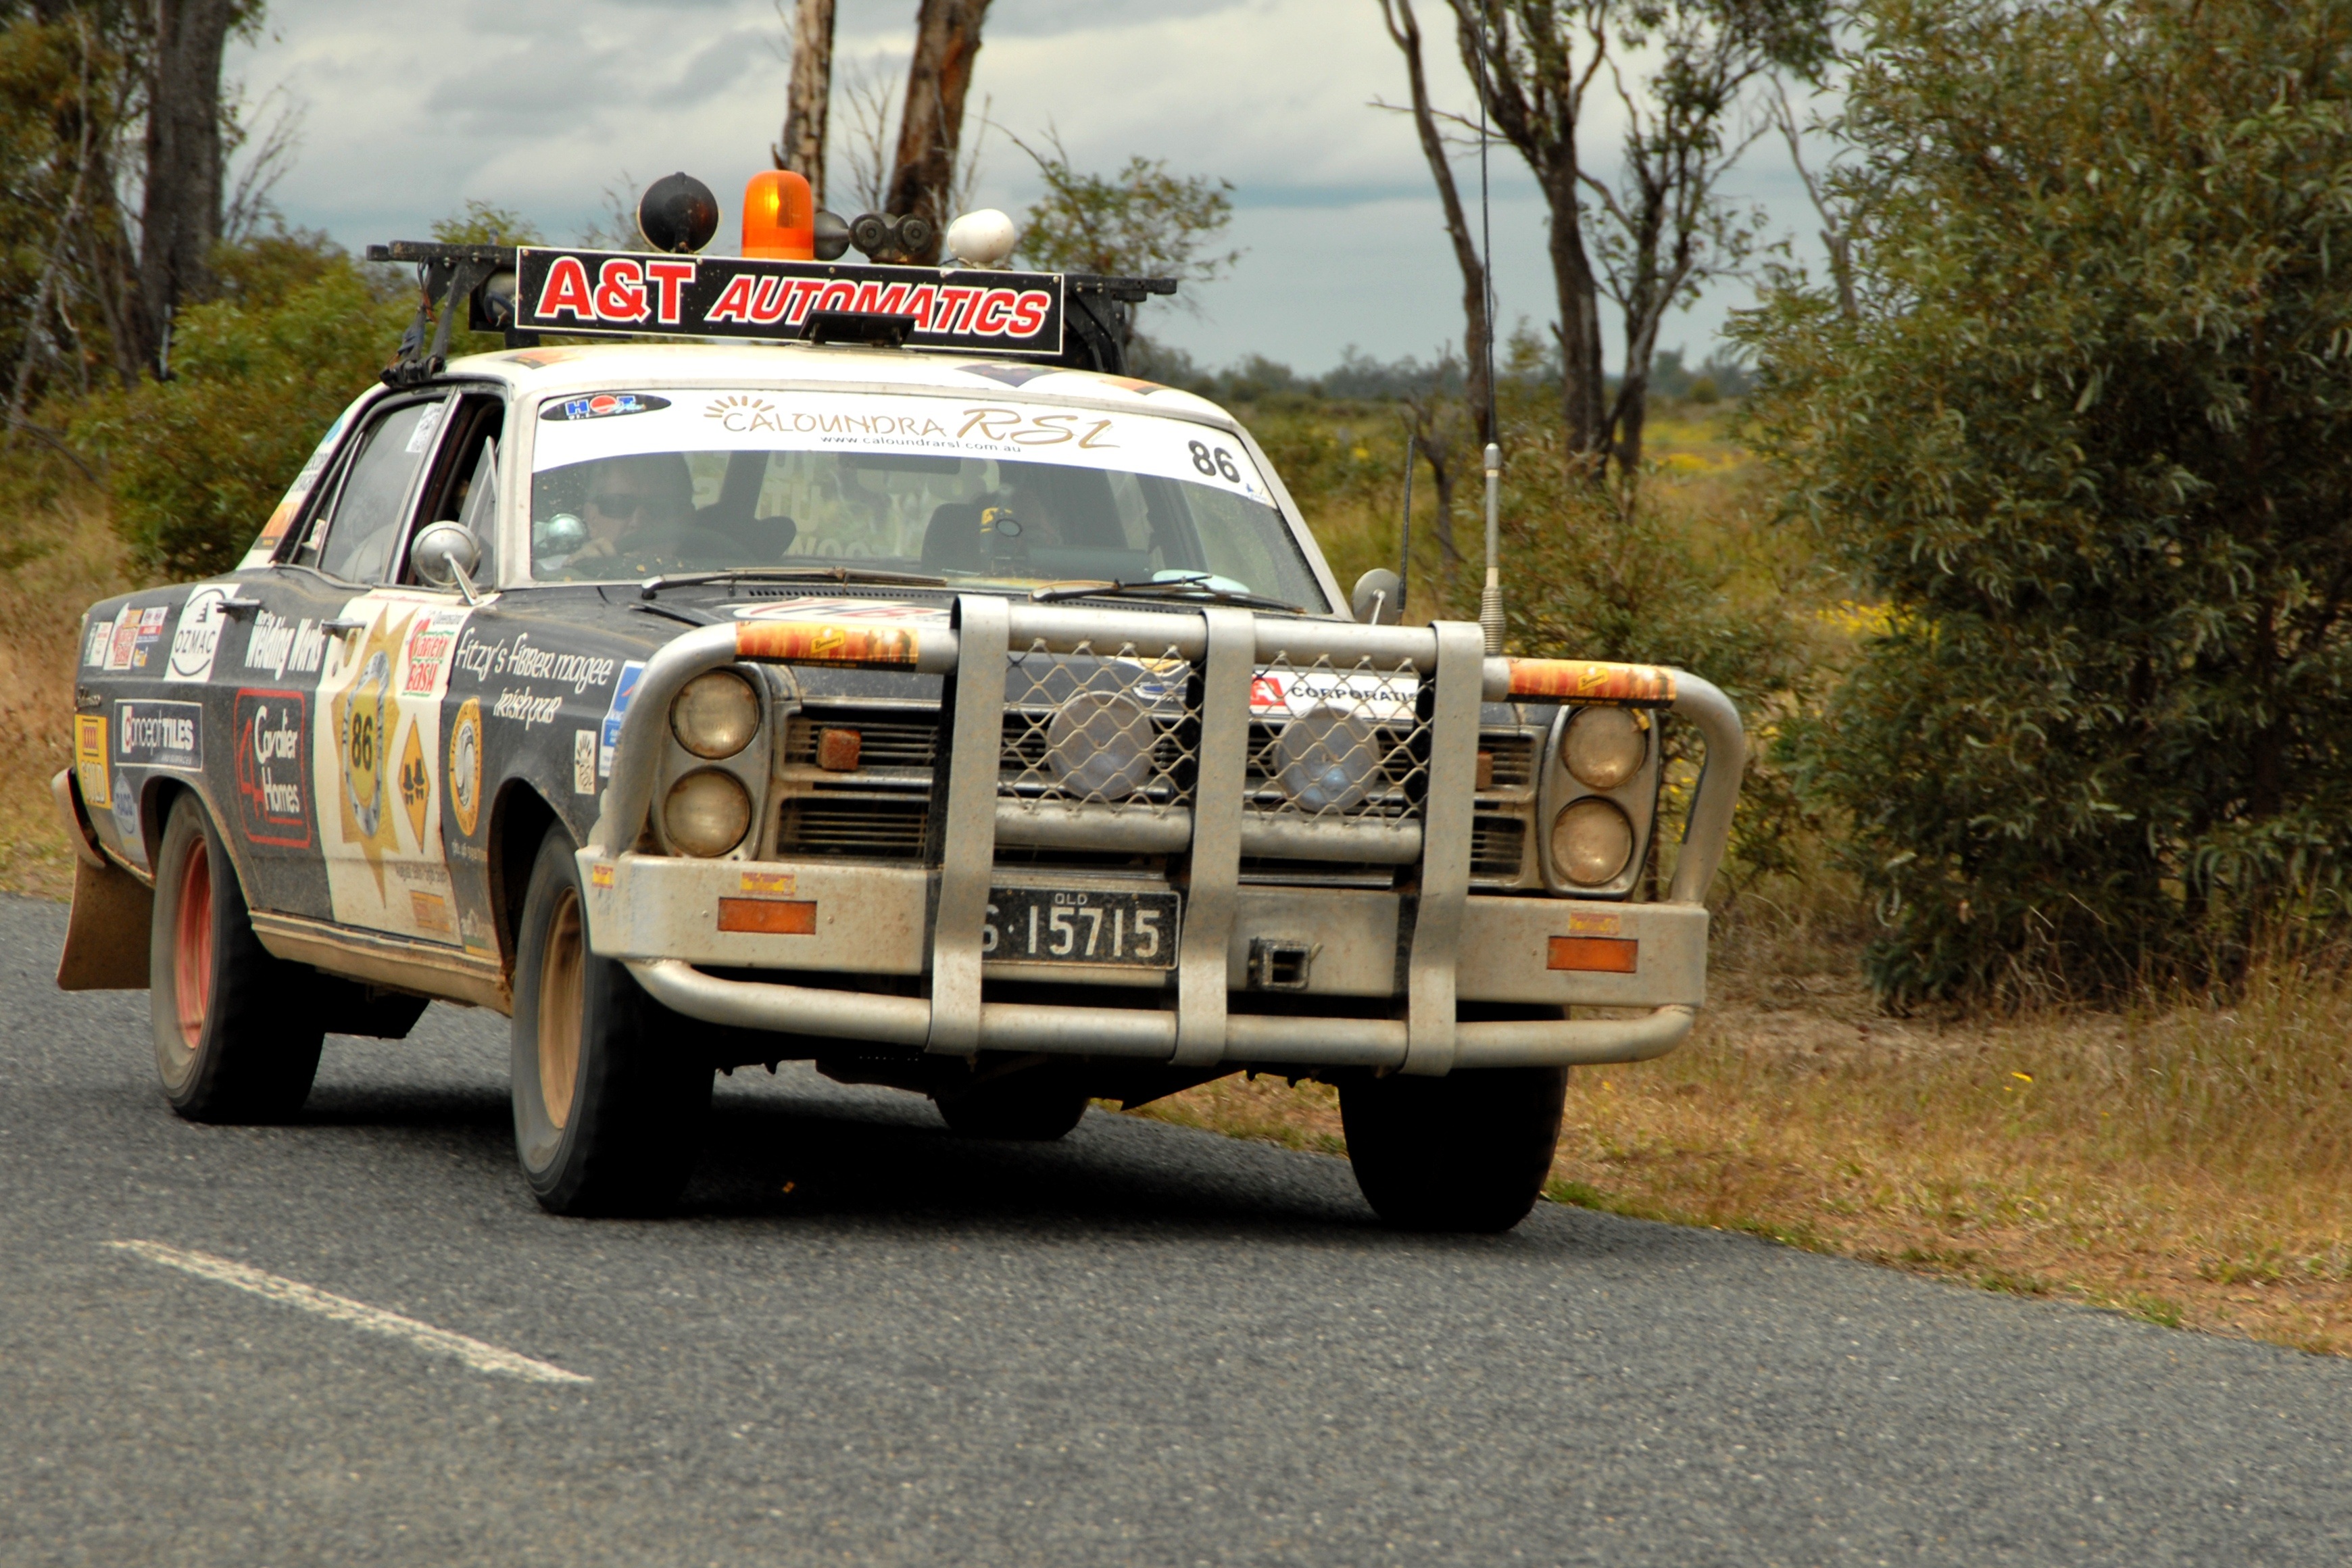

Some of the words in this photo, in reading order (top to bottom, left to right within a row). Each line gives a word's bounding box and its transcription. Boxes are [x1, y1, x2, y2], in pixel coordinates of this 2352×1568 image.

[535, 256, 695, 324] A&T
[706, 274, 1052, 339] AUTOMATICS
[723, 412, 947, 437] CALOUNDRA
[957, 408, 1121, 449] RSL
[820, 436, 1022, 453] www.caloundrarsl.com.au
[1187, 439, 1241, 484] 86
[174, 629, 217, 654] OZMAC
[351, 712, 374, 771] 86
[262, 766, 300, 813] Homes
[1055, 893, 1087, 905] QLD
